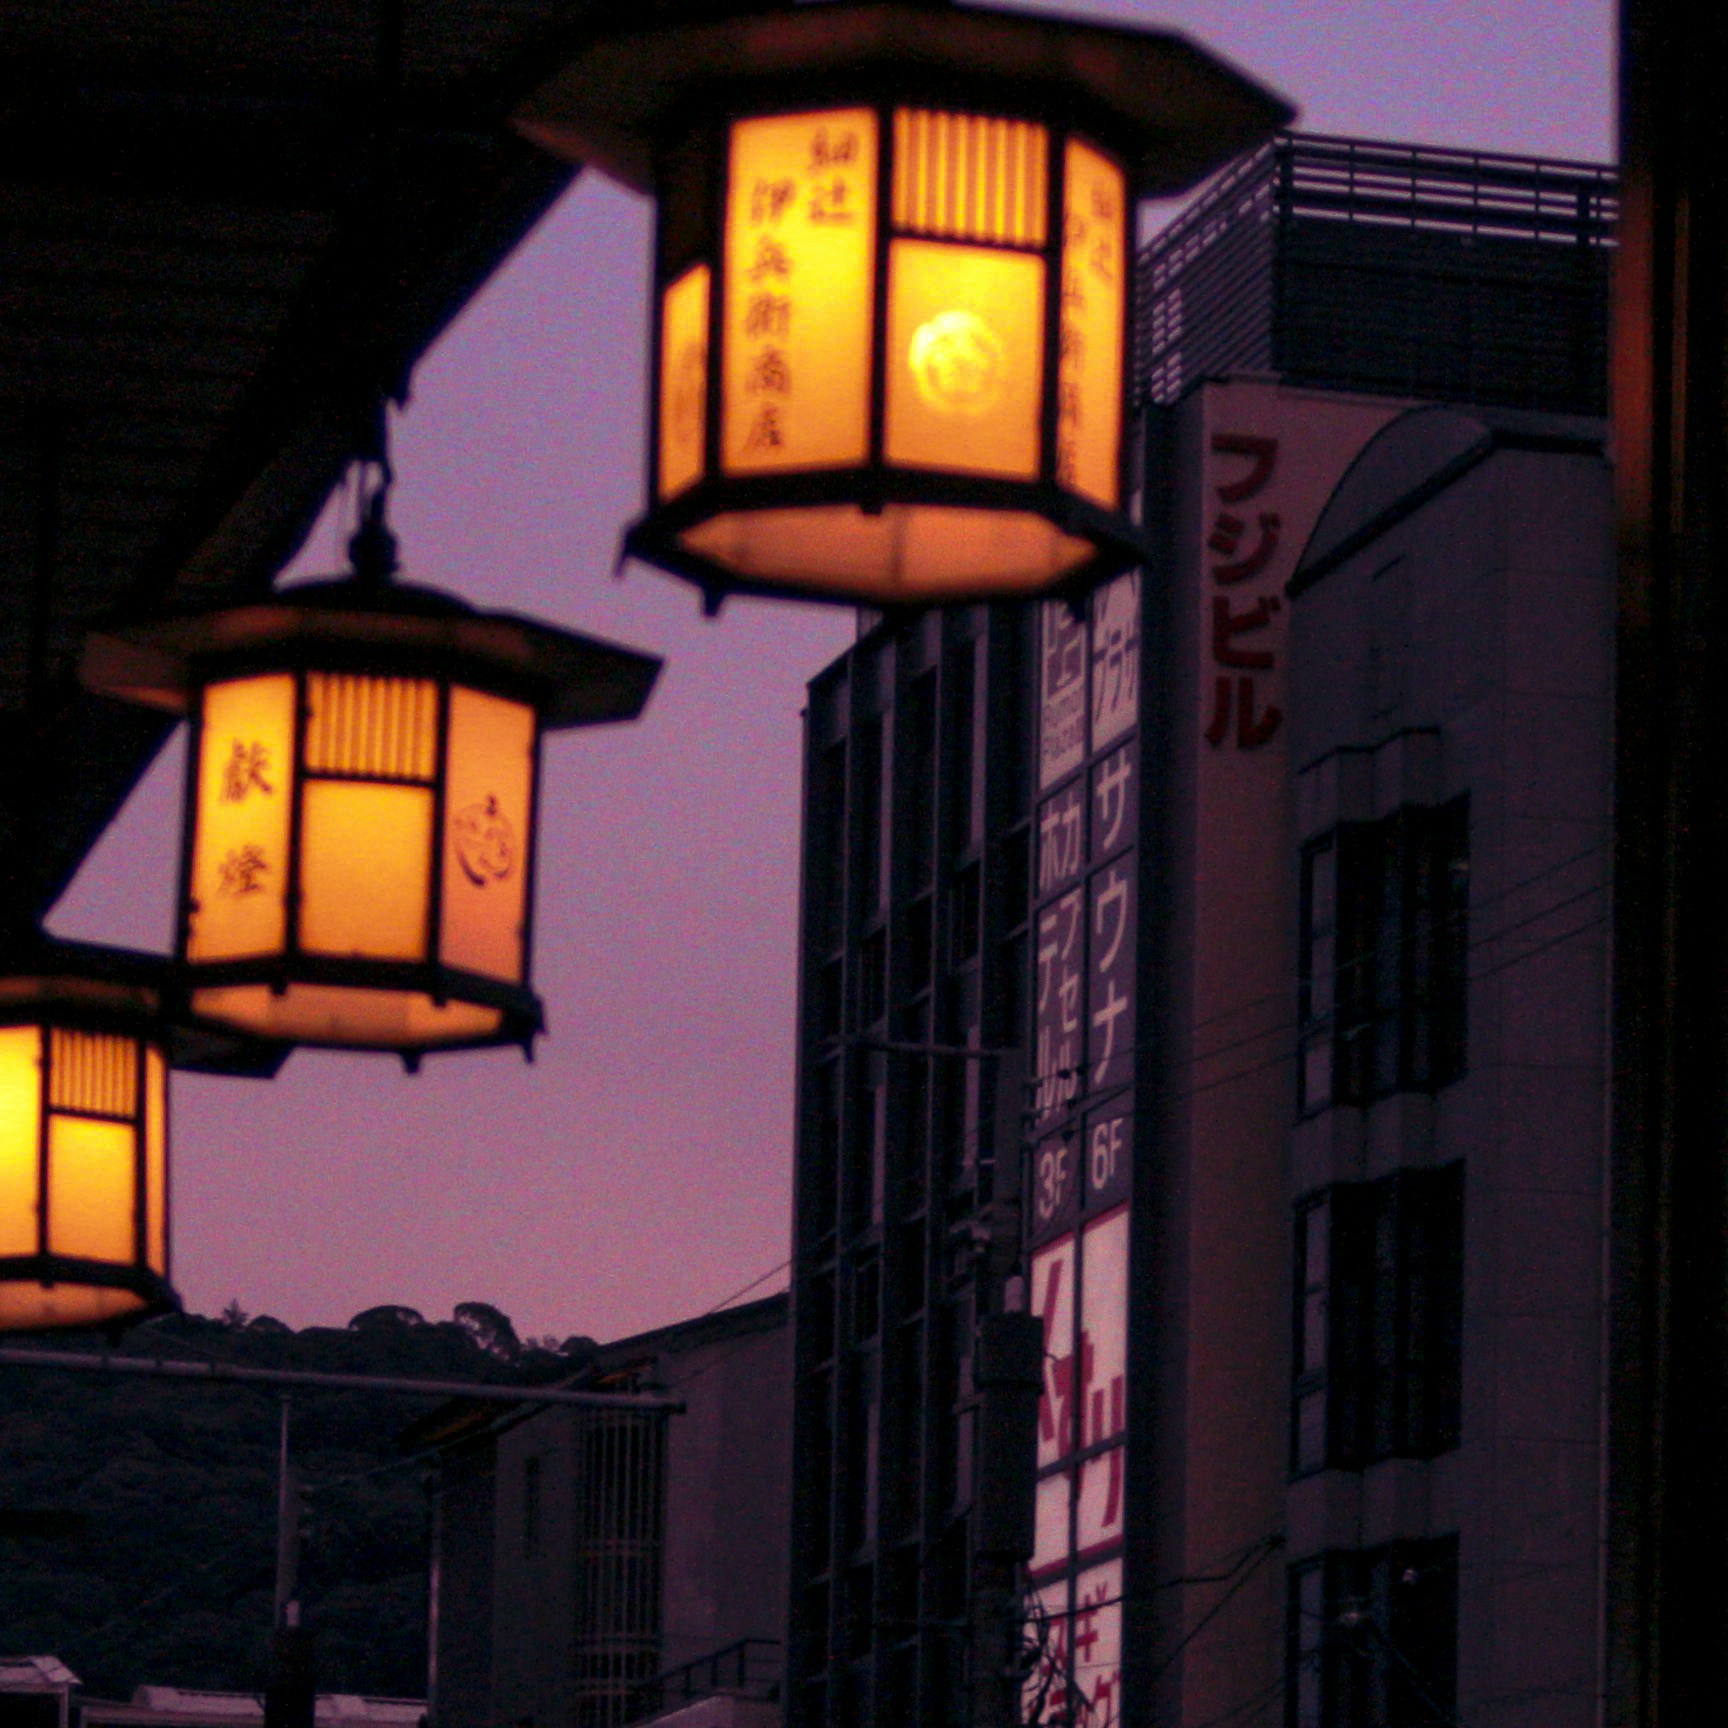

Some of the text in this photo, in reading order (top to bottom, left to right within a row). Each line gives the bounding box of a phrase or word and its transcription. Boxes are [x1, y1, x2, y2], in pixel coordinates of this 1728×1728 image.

[1204, 432, 1282, 749] フジビル
[1035, 803, 1062, 1132] ホテル
[1057, 799, 1082, 1104] カプセル
[1093, 749, 1132, 1085] サウナ
[1037, 1149, 1067, 1219] 3F
[1091, 1116, 1124, 1191] 6F
